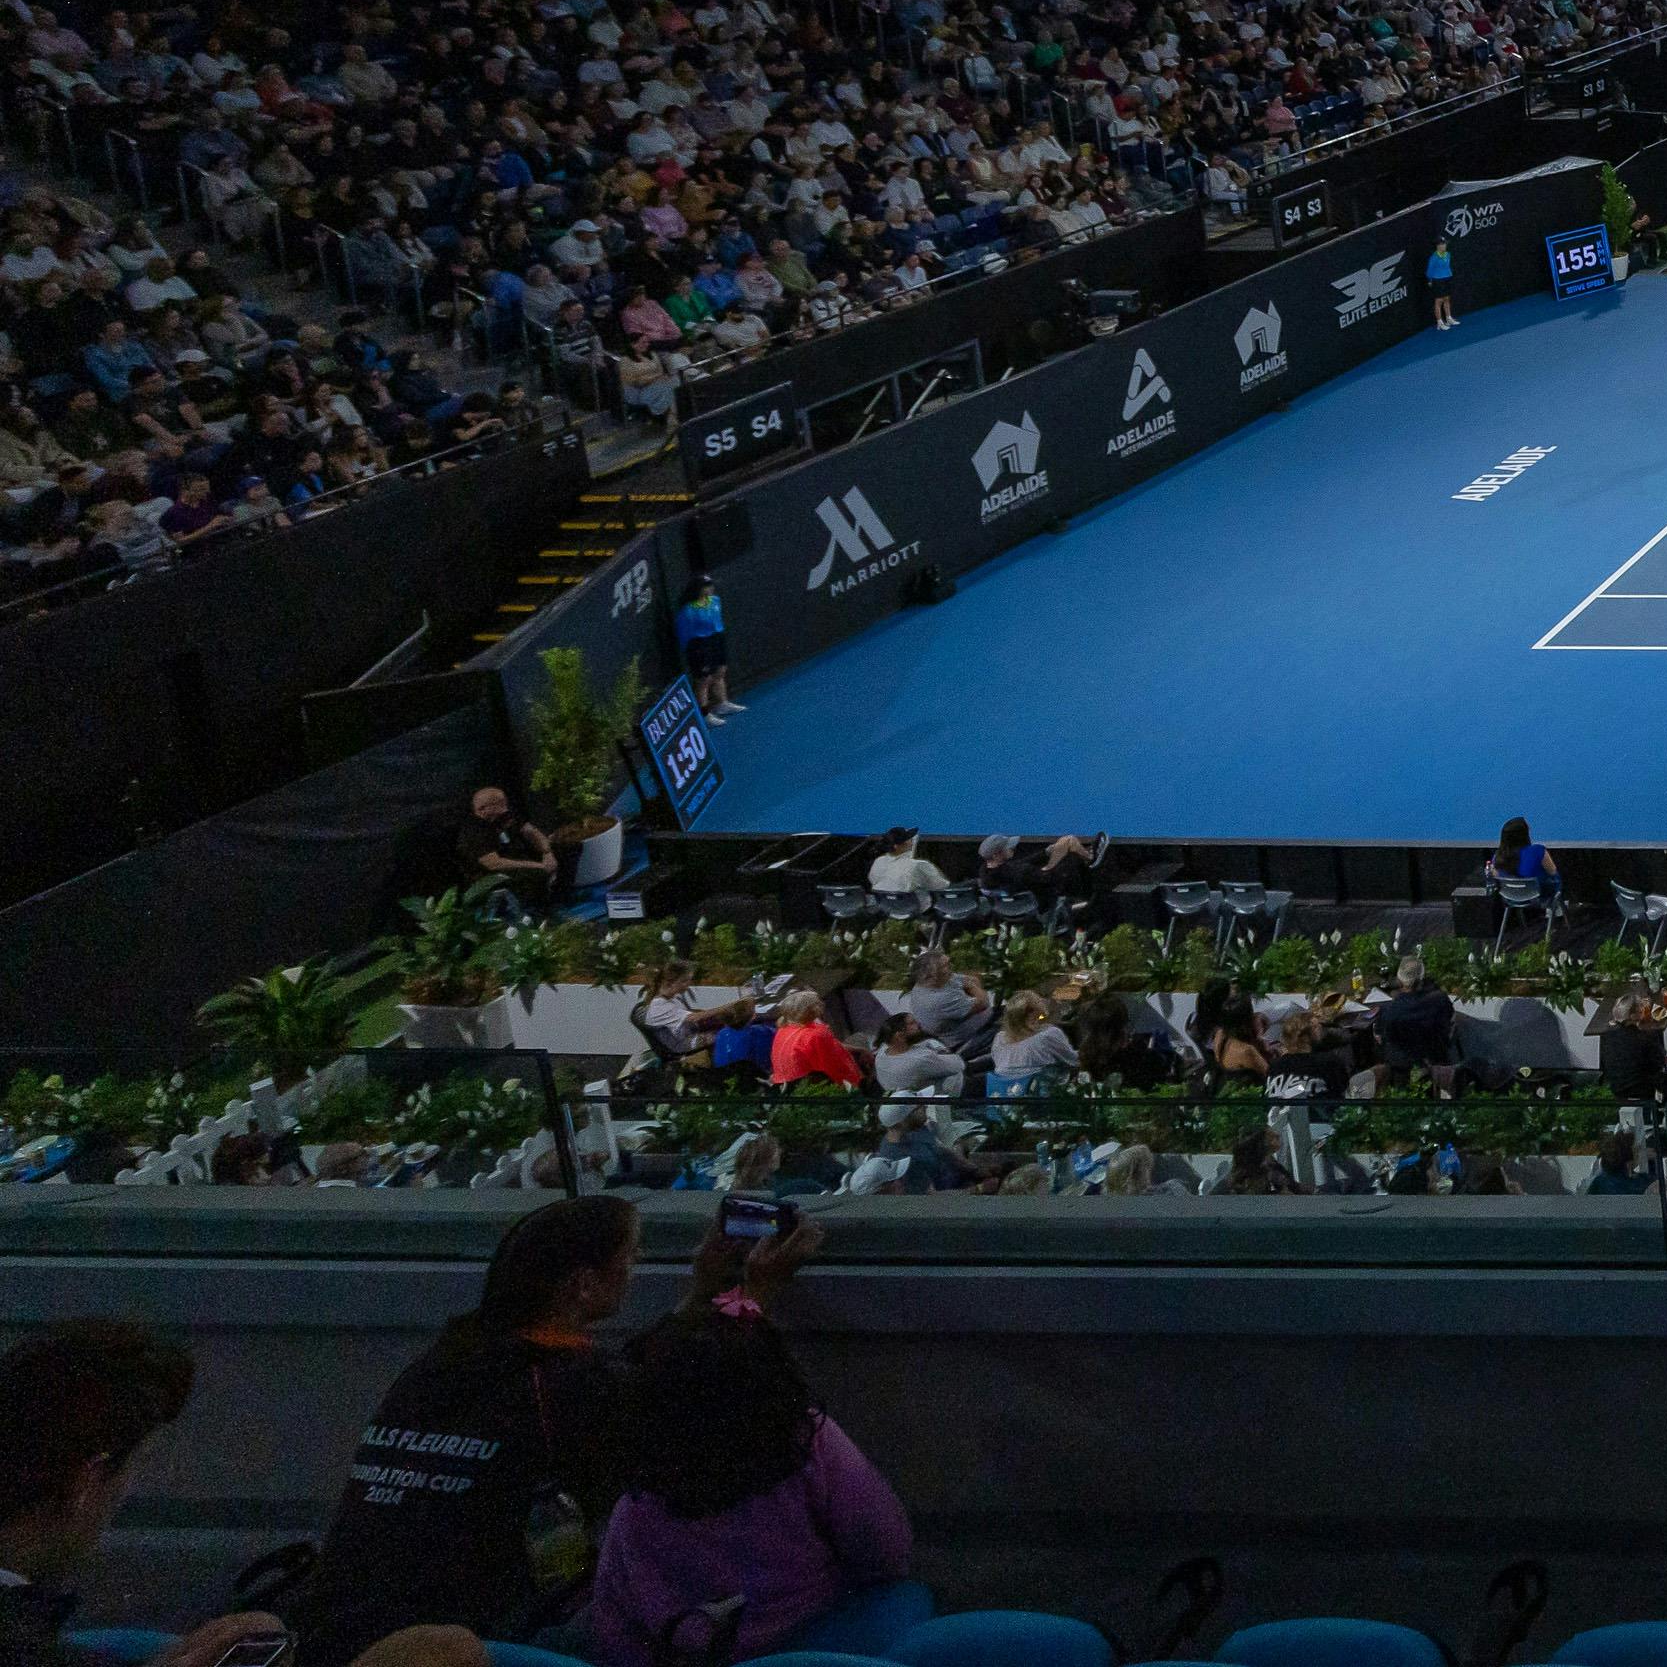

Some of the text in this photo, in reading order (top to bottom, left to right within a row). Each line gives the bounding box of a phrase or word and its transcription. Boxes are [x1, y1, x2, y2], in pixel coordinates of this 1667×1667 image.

[1583, 83, 1593, 97] S3
[1284, 198, 1321, 226] S4 S3
[1473, 202, 1504, 215] WTA
[1474, 215, 1498, 230] 500
[1556, 244, 1597, 274] 155
[1339, 285, 1407, 329] ELITE ELEVEN
[1240, 350, 1287, 387] ADELAIDE
[704, 409, 783, 457] S5 S4
[1106, 409, 1177, 456] ADELAIDE
[1451, 445, 1558, 502] ADELAIDE
[980, 469, 1049, 518] ADELAIDE
[830, 539, 921, 597] MARRIOTT
[667, 725, 708, 790] 1:50
[398, 1432, 504, 1461] FLEURIEU
[430, 1475, 475, 1493] CUP
